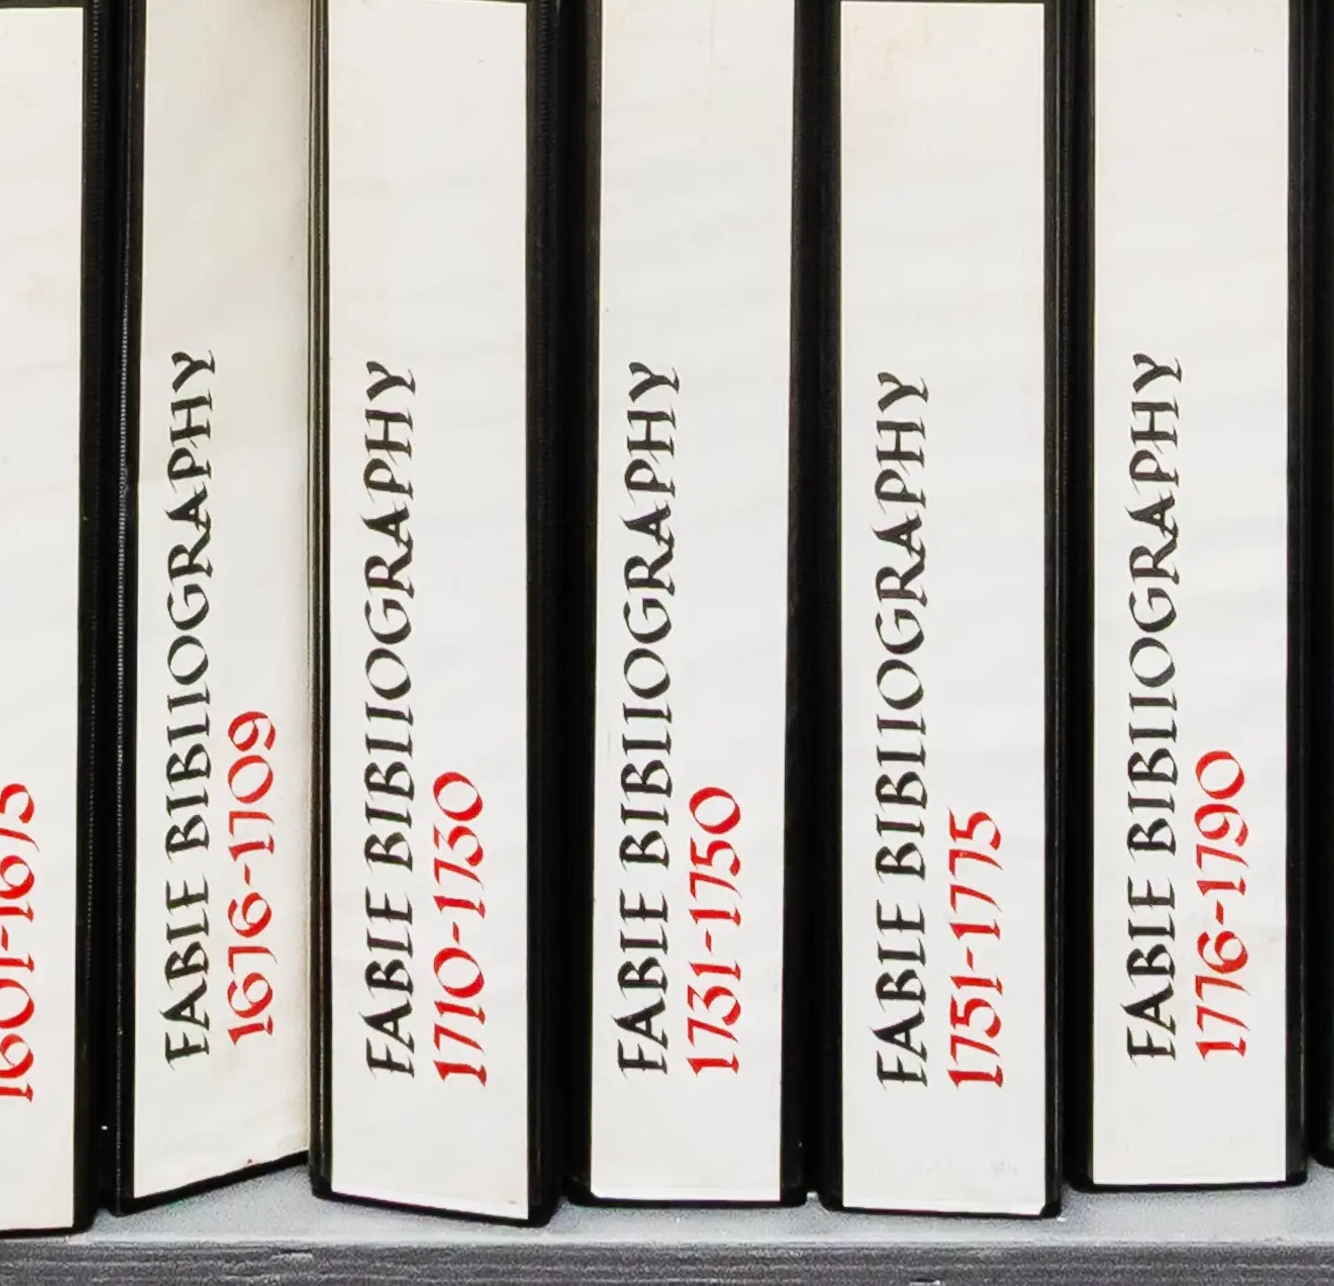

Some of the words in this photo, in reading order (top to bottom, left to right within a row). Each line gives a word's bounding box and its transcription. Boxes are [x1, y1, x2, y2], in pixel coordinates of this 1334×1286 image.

[165, 352, 215, 859] BIBLIOGRAPHY
[363, 361, 415, 871] BIBLIOGRAPHY
[873, 372, 928, 880] BIBLIOGRAPHY
[160, 880, 209, 1064] FABLE
[227, 711, 276, 1045] 1676-1709
[362, 888, 414, 1077] FABLE
[433, 772, 487, 1086] 1710-1730
[873, 900, 927, 1086] FABLE
[947, 811, 1003, 1087] 1751-1775
